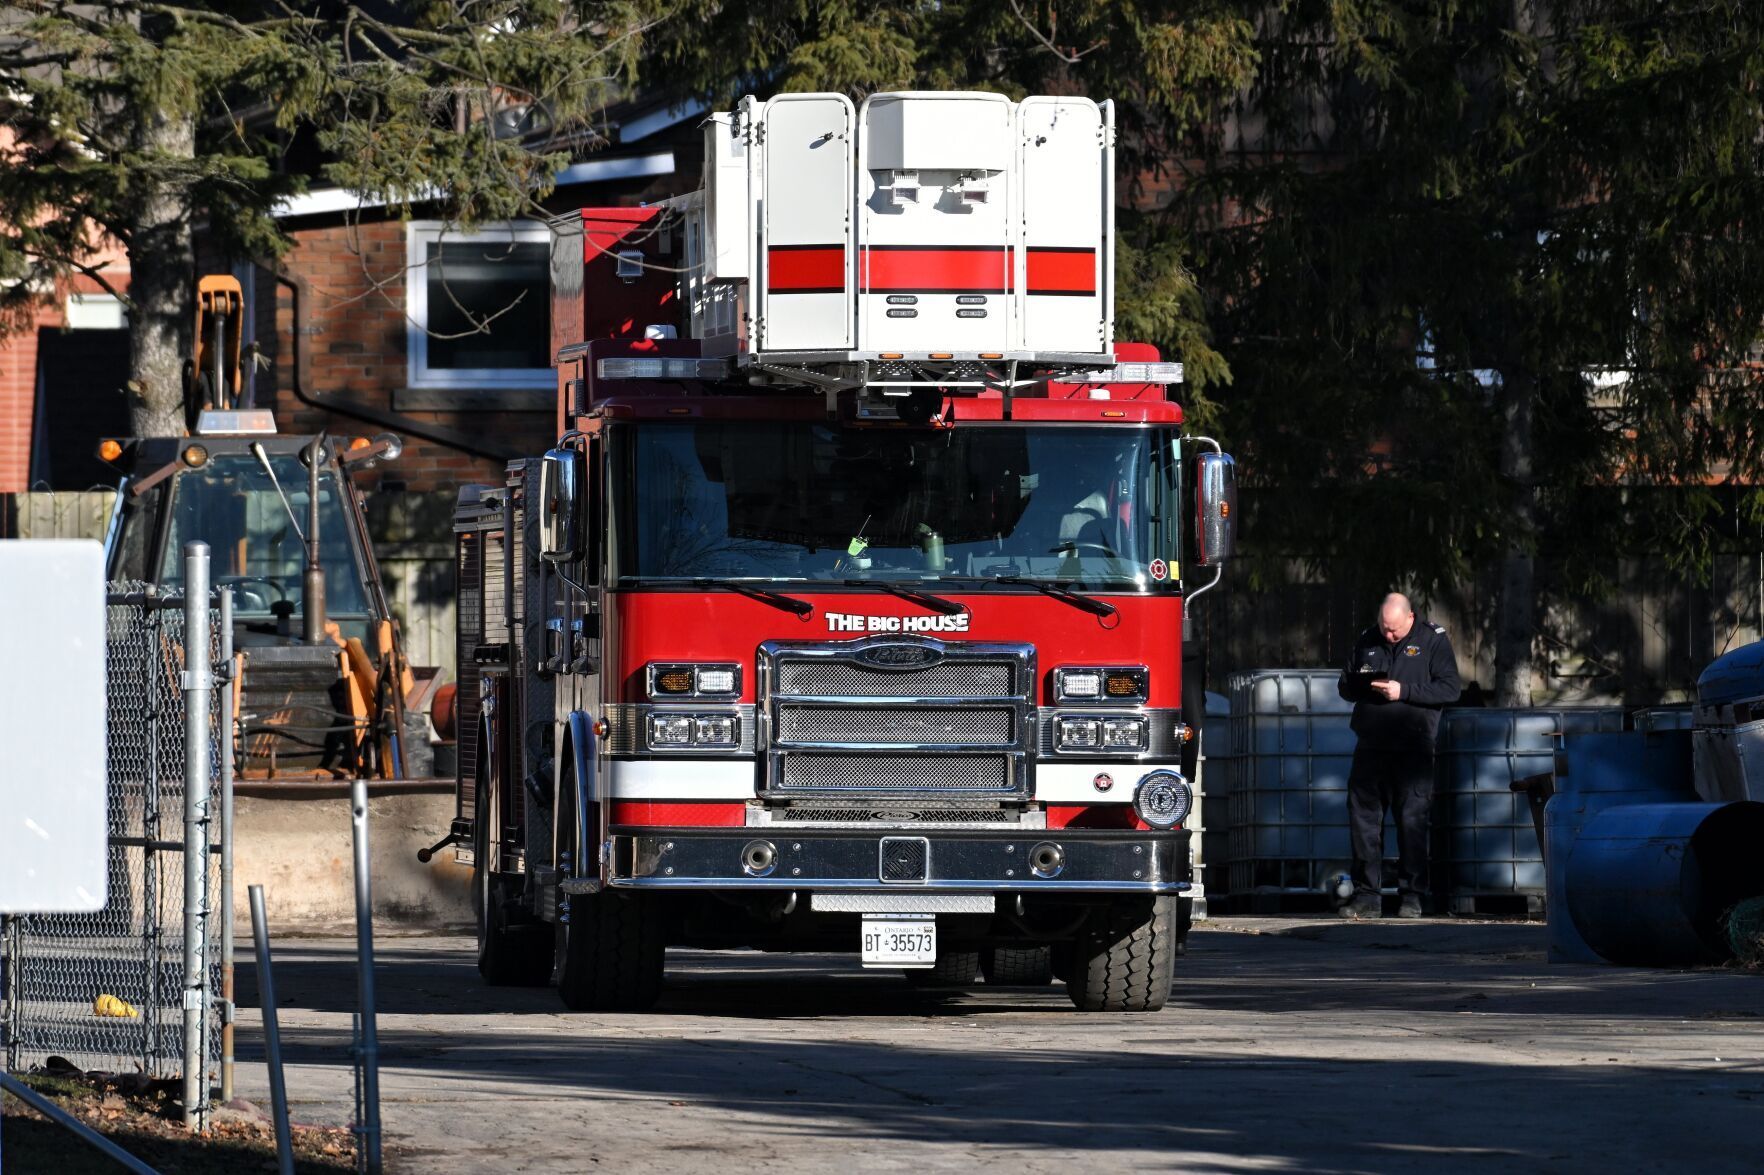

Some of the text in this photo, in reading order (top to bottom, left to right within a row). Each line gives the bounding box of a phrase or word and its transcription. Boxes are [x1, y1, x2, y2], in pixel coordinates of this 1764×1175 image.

[825, 612, 969, 632] THE BIG HOUSE
[865, 933, 932, 952] BT 35573
